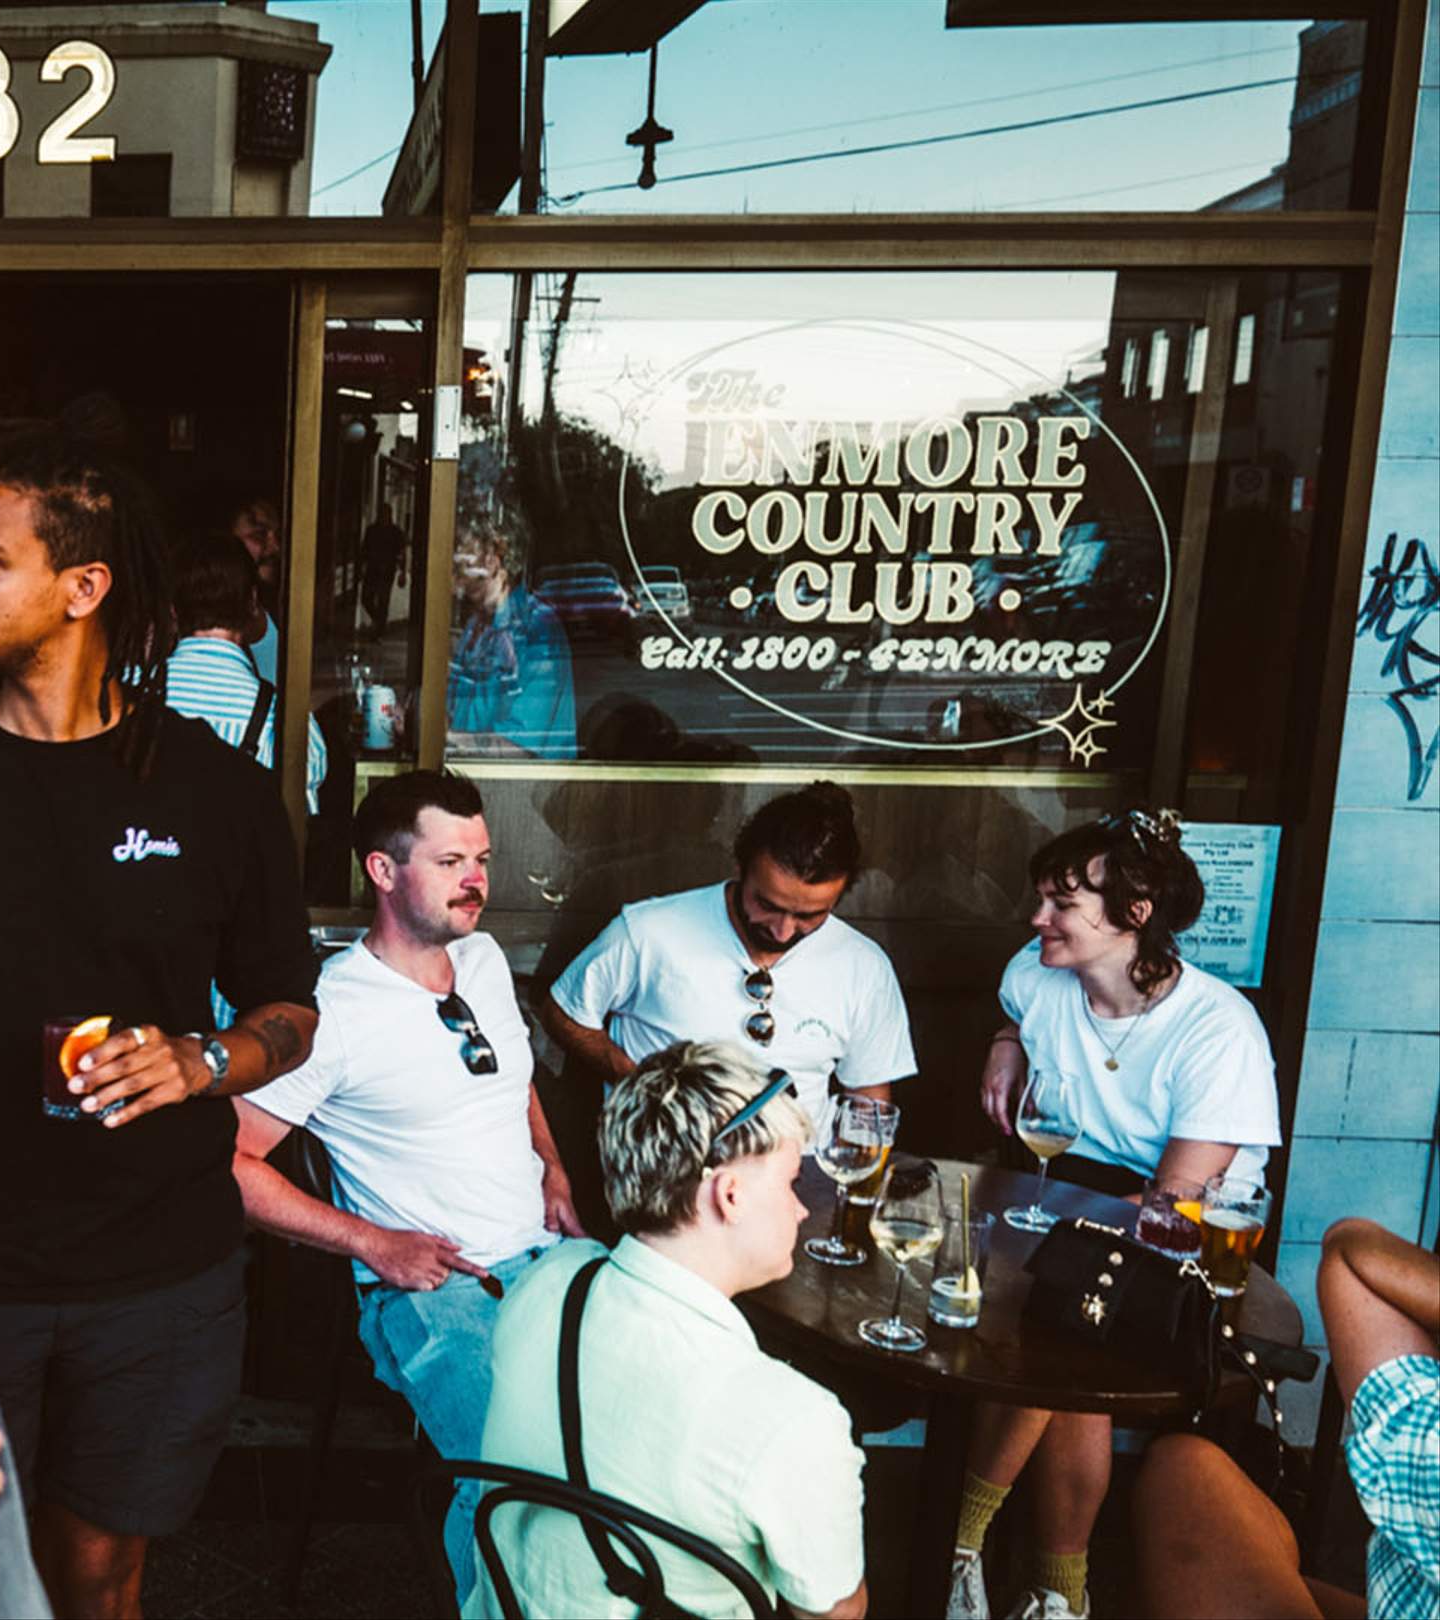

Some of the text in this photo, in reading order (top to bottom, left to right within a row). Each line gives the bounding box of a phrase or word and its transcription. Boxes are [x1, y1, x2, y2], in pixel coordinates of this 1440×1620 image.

[698, 416, 1091, 488] ENMORE
[692, 490, 1084, 556] COUNTRY
[774, 561, 976, 625] CLUB
[640, 636, 729, 670] Call:
[731, 636, 837, 672] 1800
[866, 637, 1112, 680] 4ENMORE
